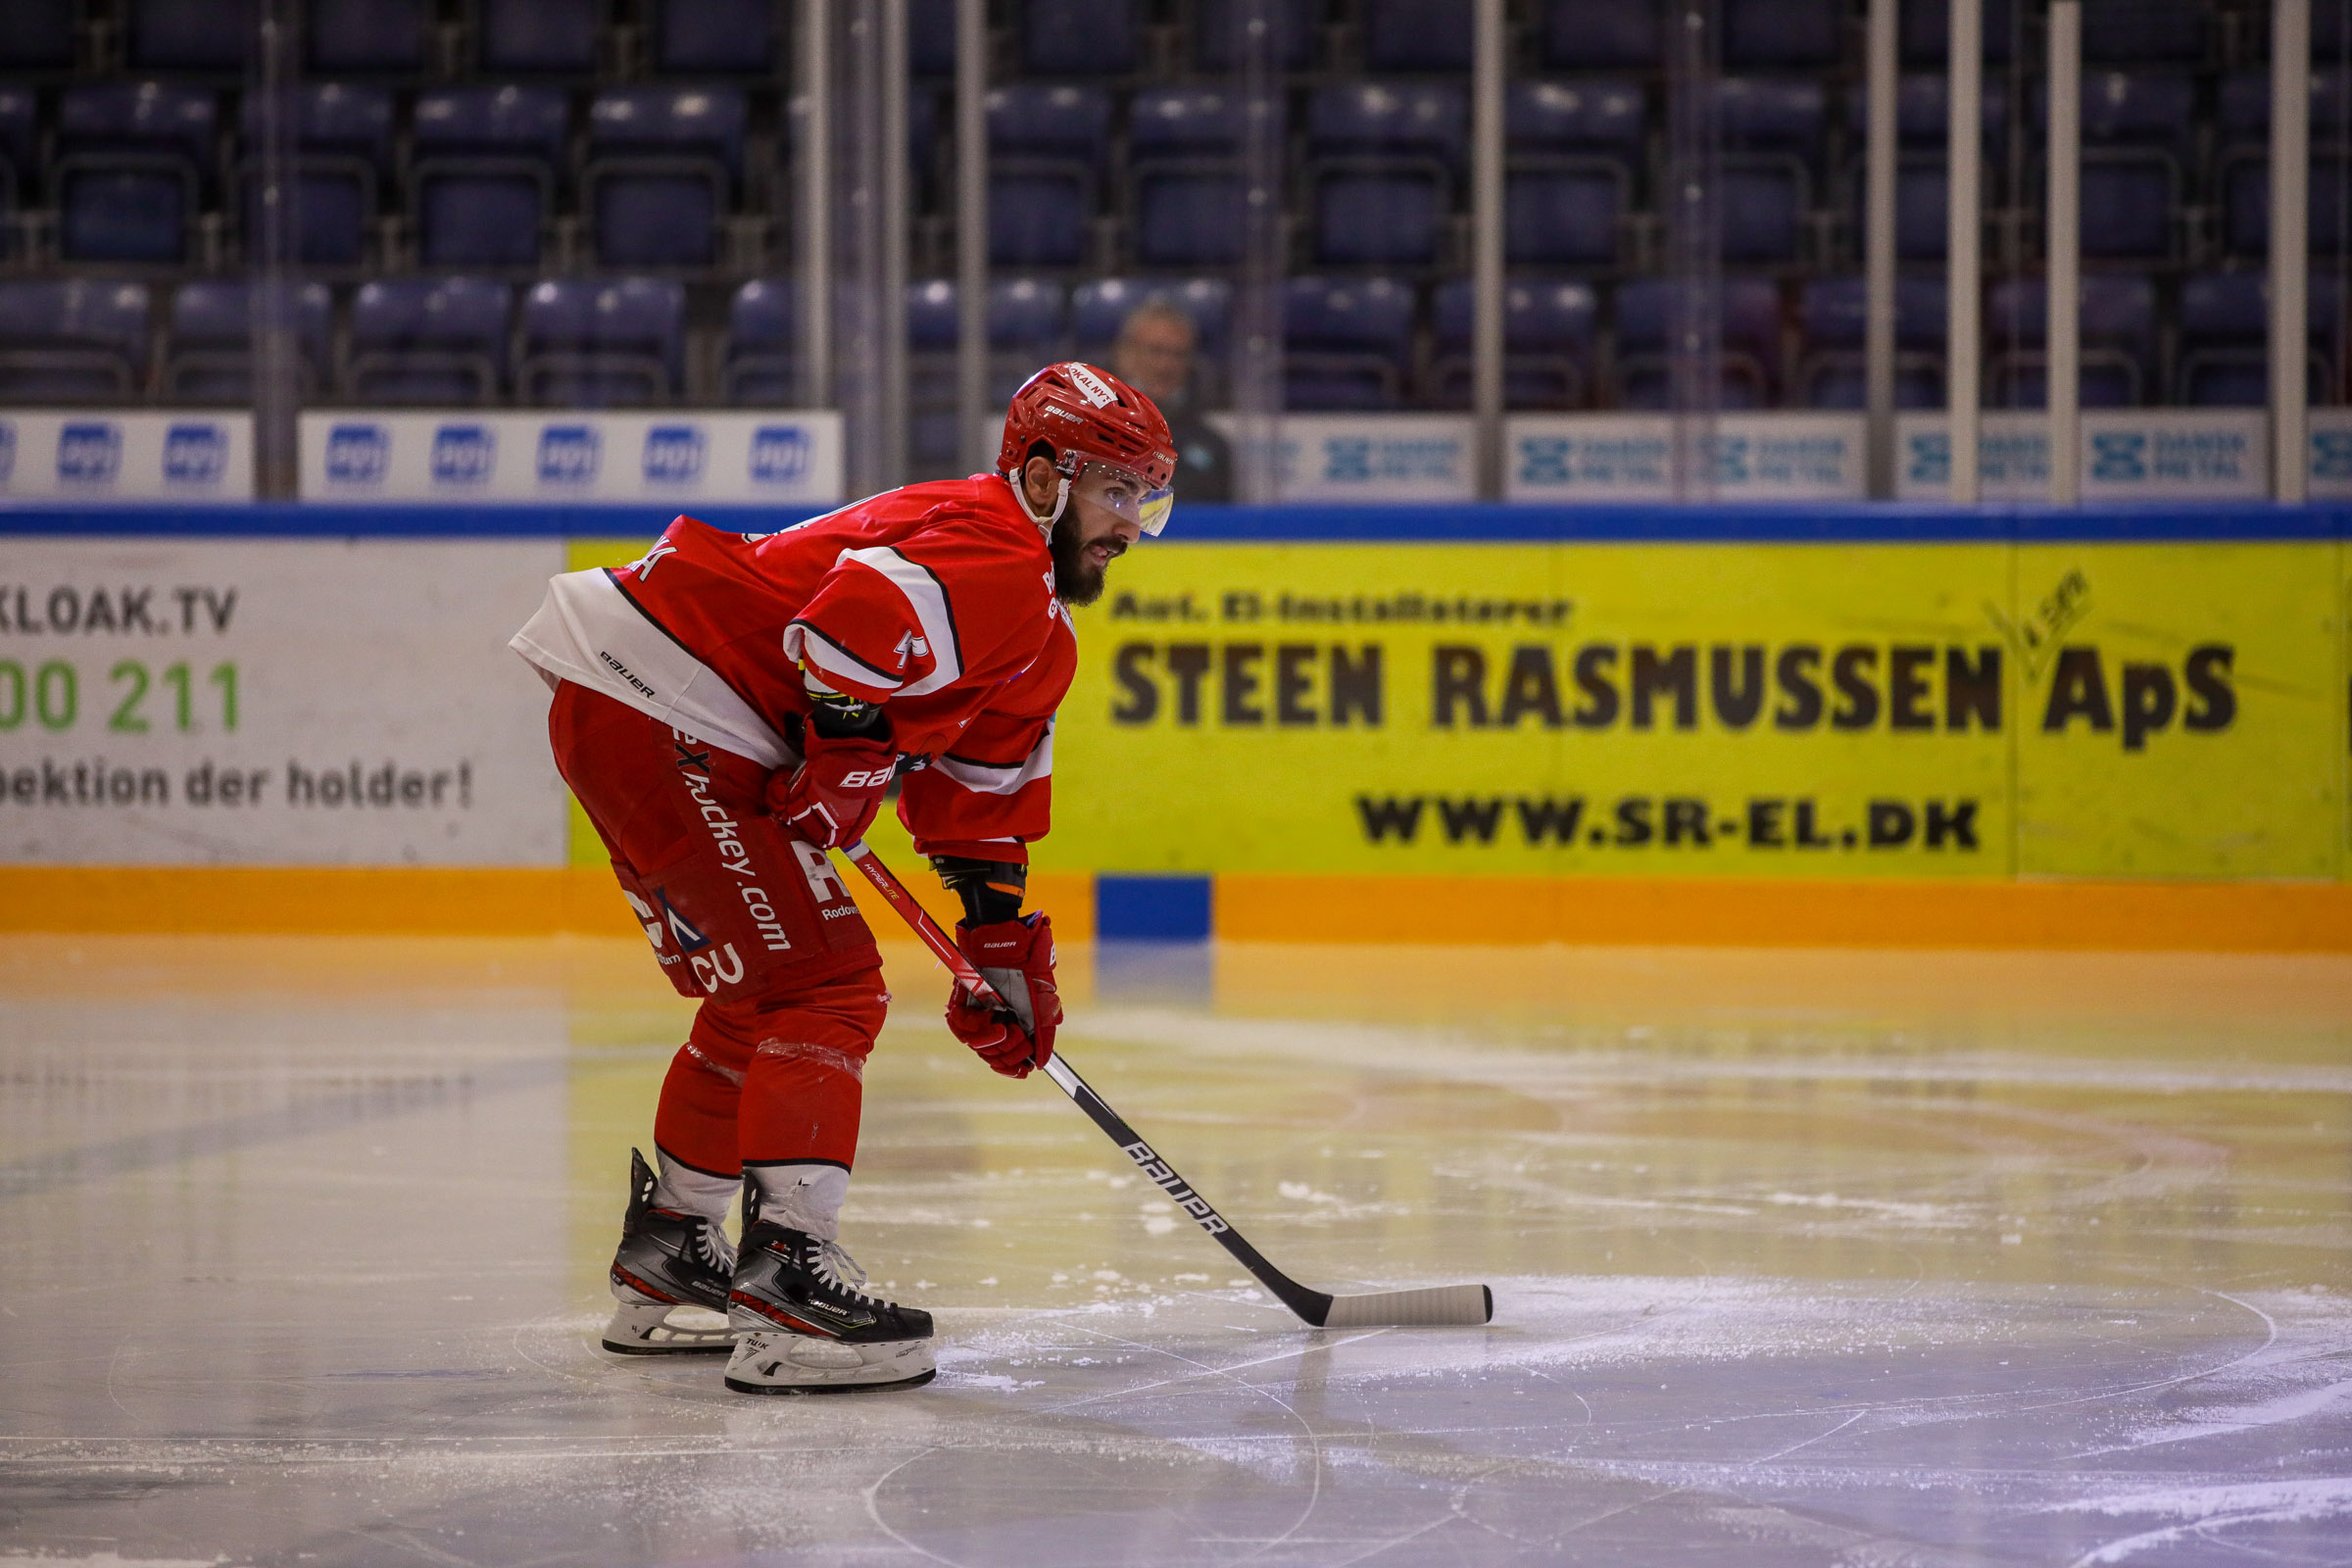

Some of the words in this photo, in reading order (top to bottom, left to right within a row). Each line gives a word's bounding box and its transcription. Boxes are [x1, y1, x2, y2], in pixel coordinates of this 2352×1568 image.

[1044, 405, 1084, 425] BAUER
[108, 658, 239, 733] 211
[599, 650, 656, 699] BAUER
[1110, 640, 1383, 730] STEEN
[1432, 642, 2003, 735] RASMUSSEN
[2041, 642, 2238, 753] ApS
[184, 756, 272, 808] der
[287, 756, 473, 809] holder!
[1354, 794, 1981, 850] WWW.SR-EL.DK
[863, 863, 901, 901] HYPERLITE
[1121, 1141, 1230, 1236] BAUER
[691, 1279, 728, 1298] BAUER
